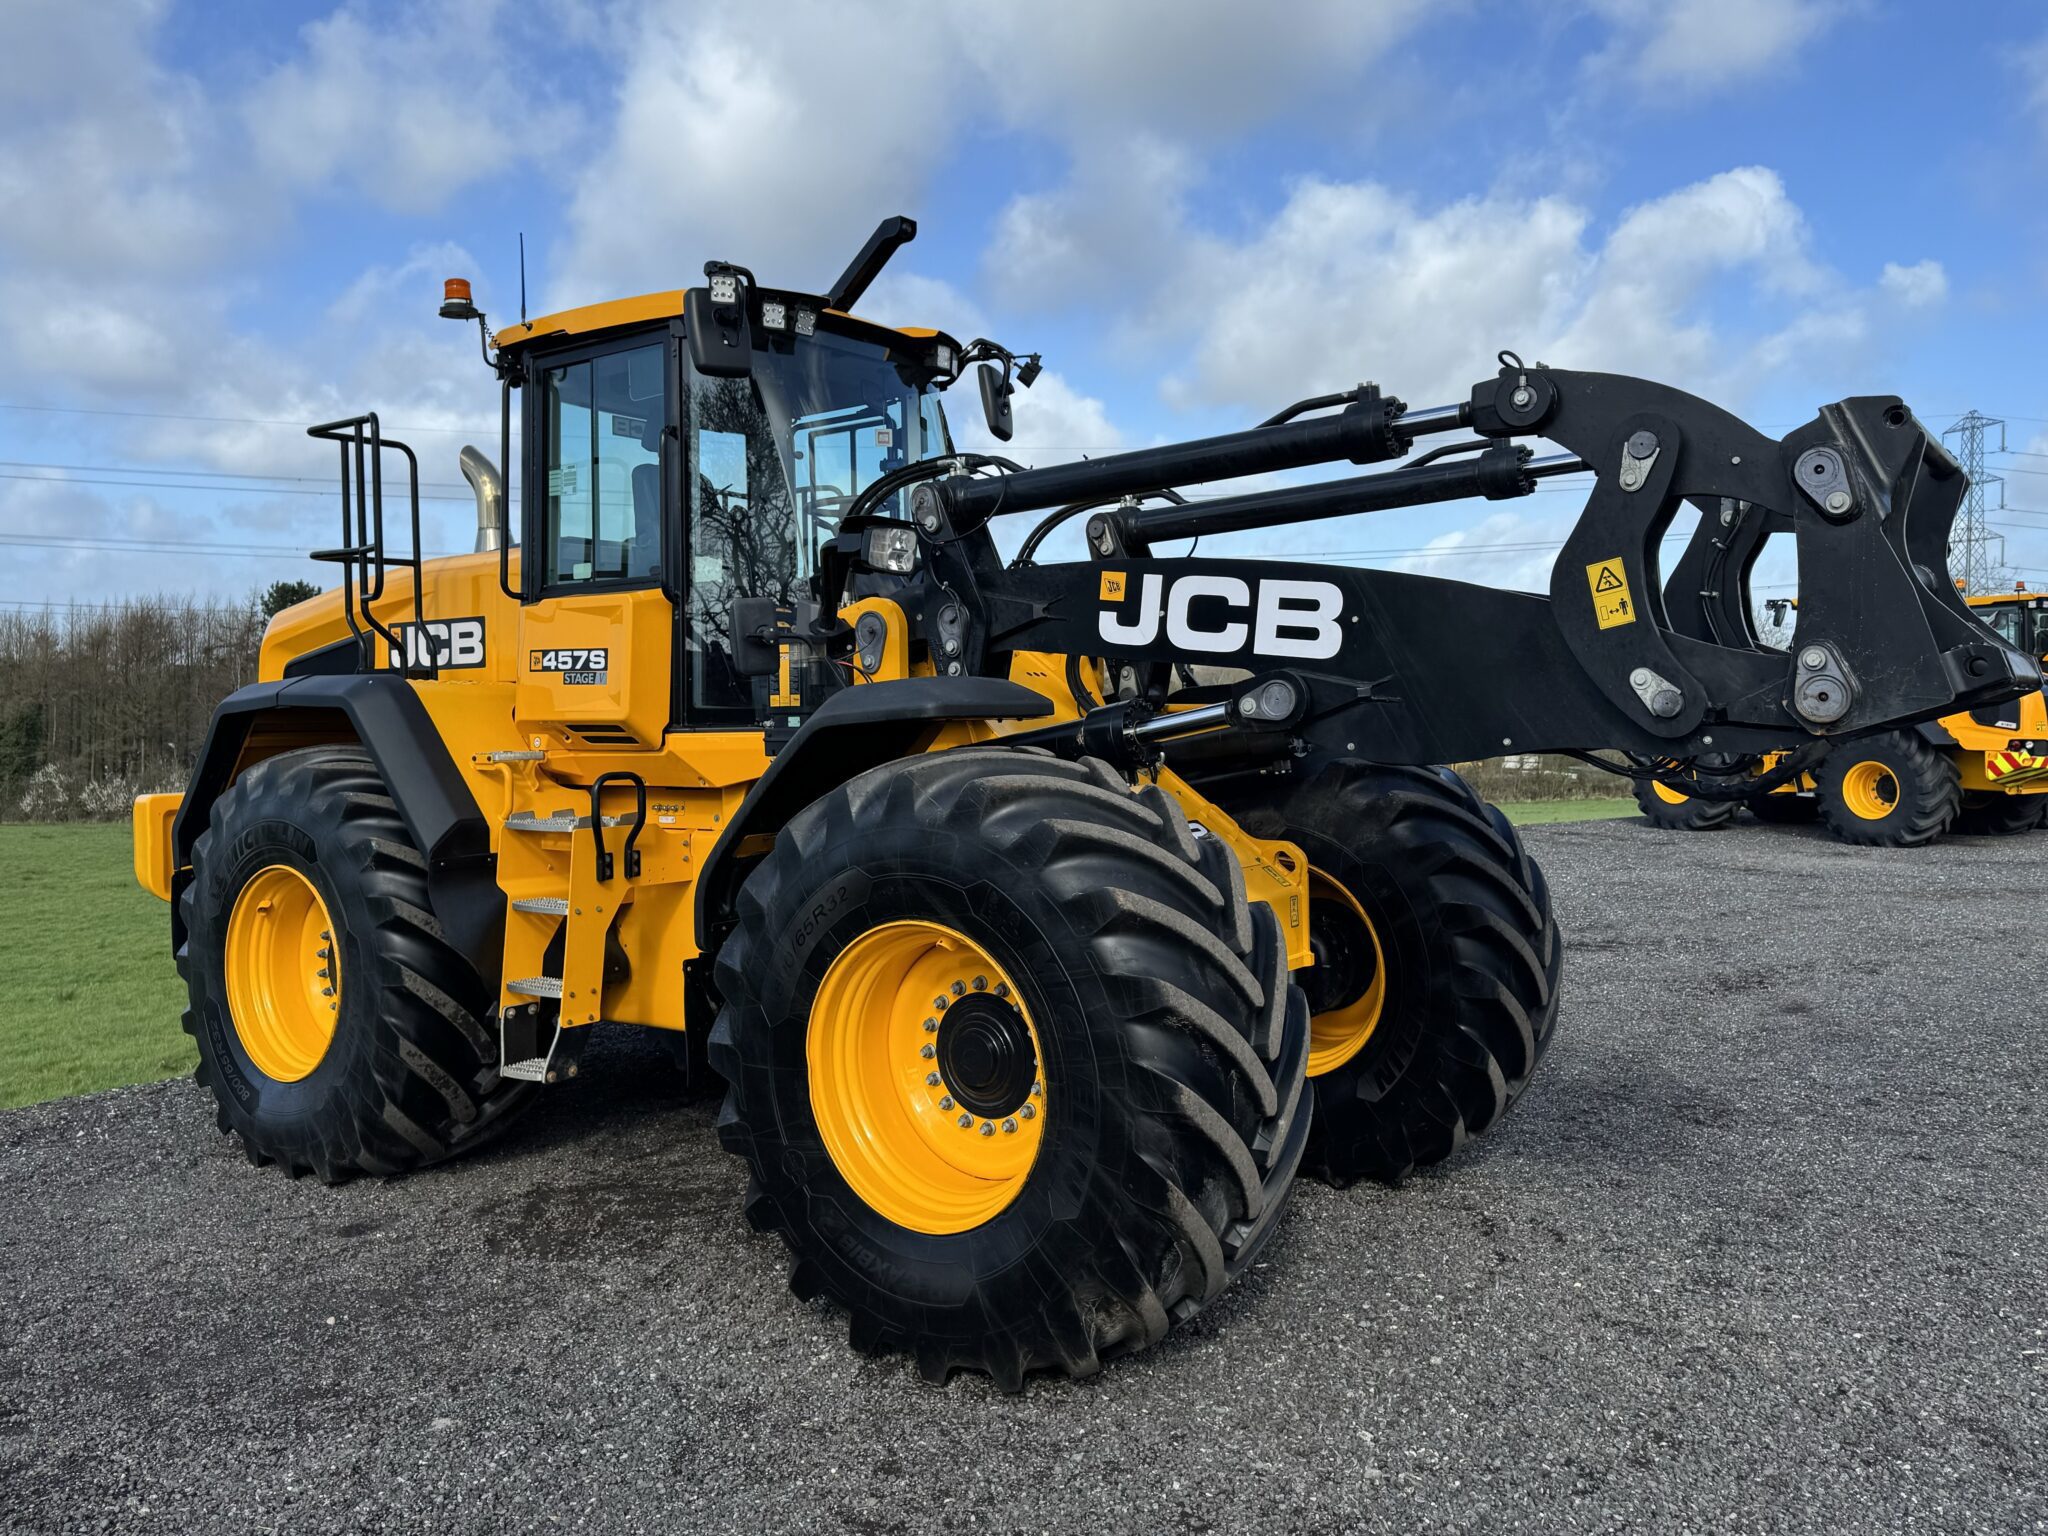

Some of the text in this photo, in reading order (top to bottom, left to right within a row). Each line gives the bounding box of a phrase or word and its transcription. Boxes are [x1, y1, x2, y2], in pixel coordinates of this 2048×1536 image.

[1107, 580, 1121, 593] JCB
[1099, 574, 1344, 660] JCB
[391, 621, 484, 668] JCB
[543, 649, 606, 670] 457S
[564, 673, 594, 684] STAGE
[777, 886, 849, 996] 80/65R32
[210, 1019, 250, 1101] 800/65R32
